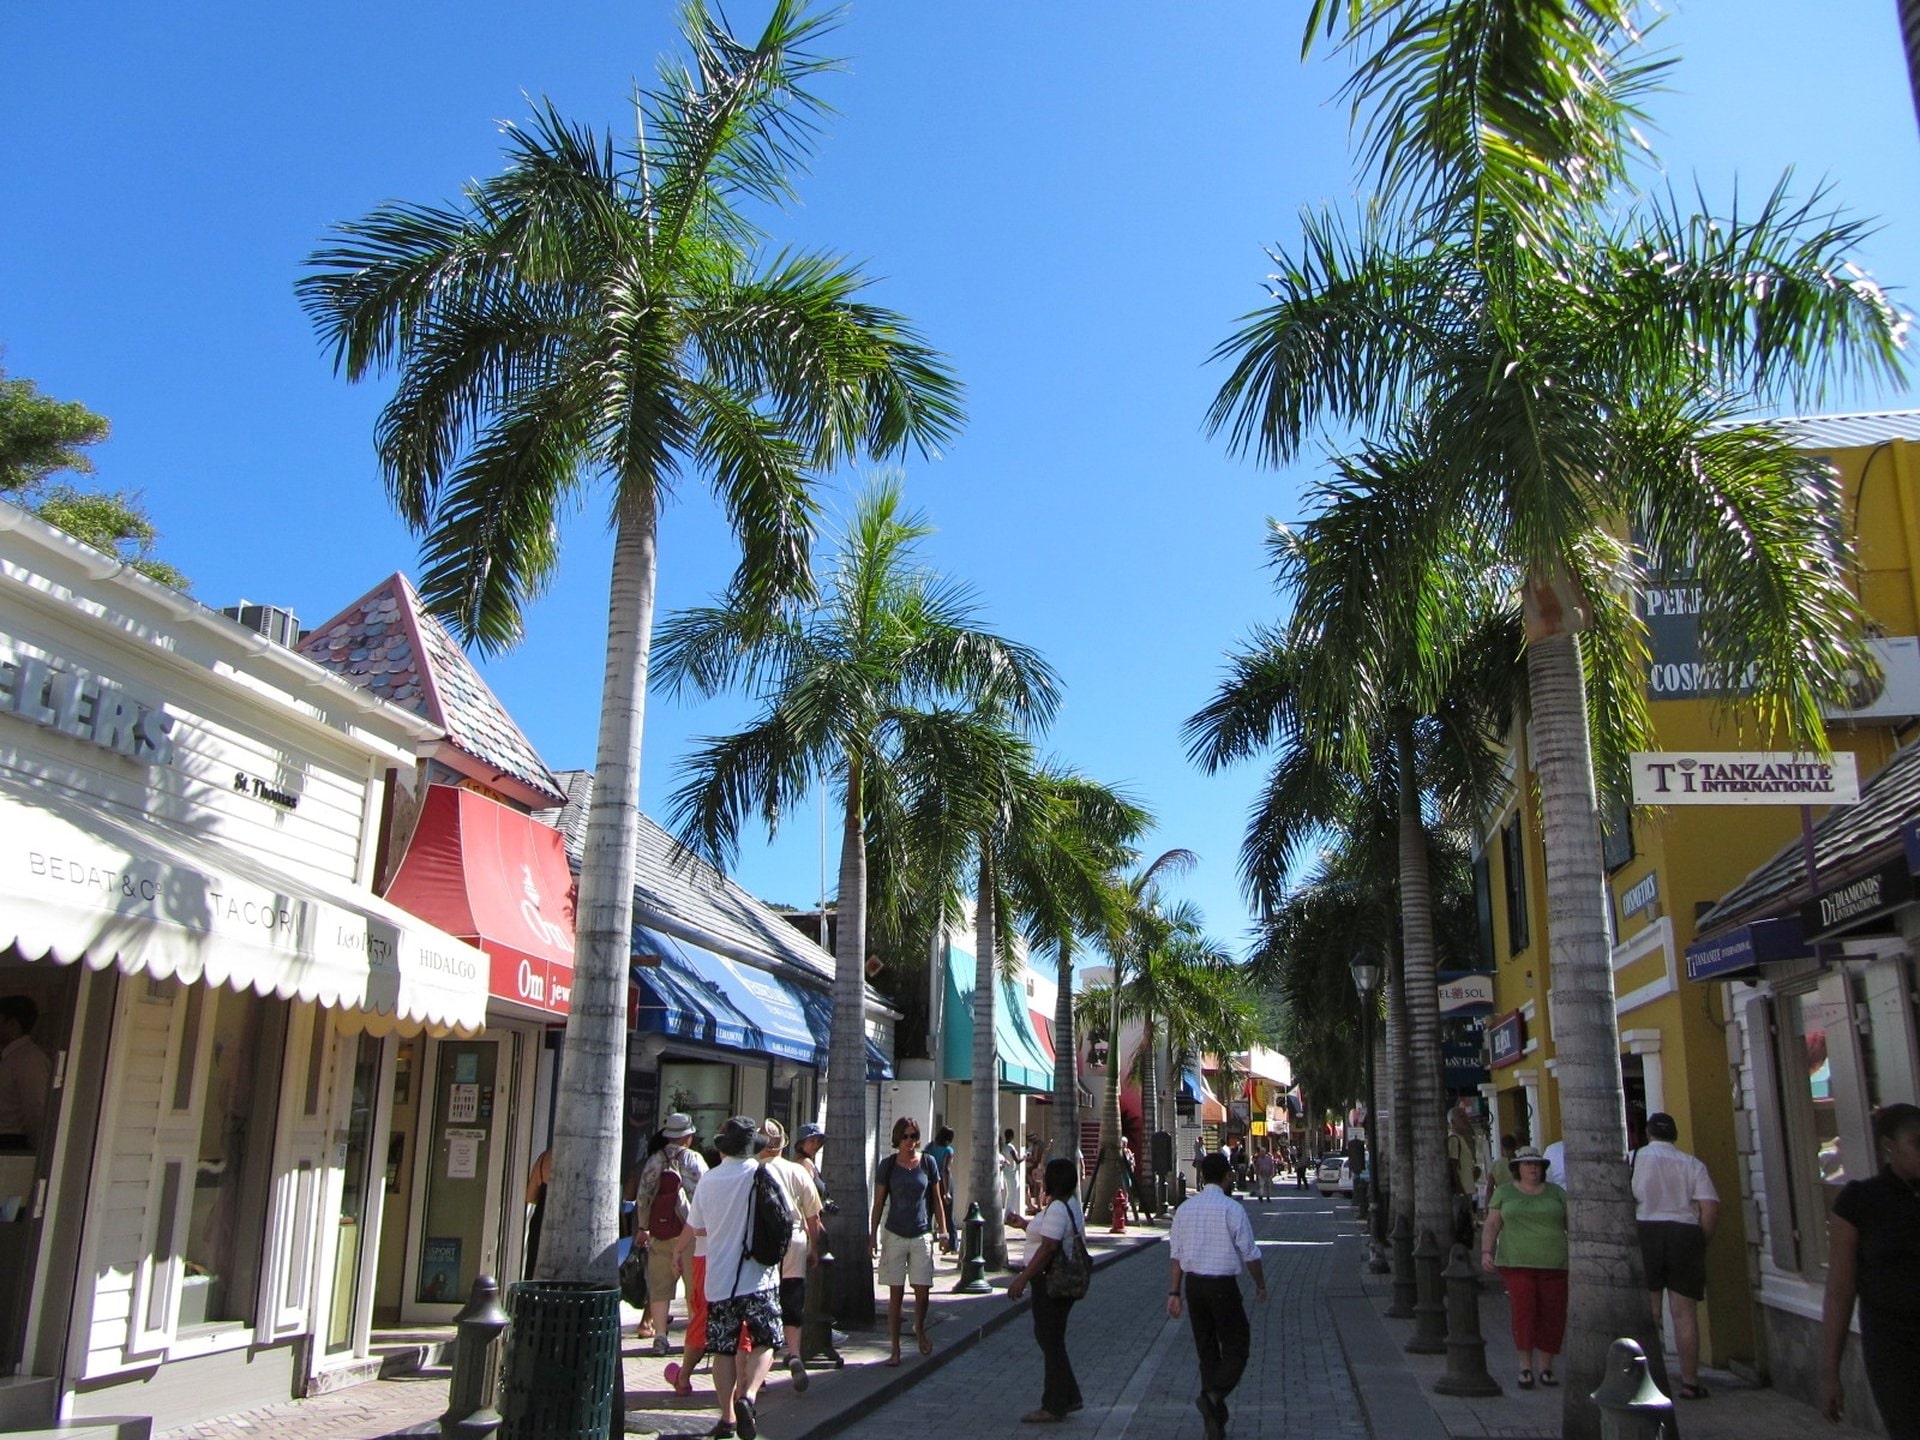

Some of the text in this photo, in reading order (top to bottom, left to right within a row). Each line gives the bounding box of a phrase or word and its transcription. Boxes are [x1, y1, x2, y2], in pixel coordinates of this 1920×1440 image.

[1699, 763, 1833, 781] TANZANITE
[1702, 780, 1834, 793] INTERNATIONAL
[234, 771, 298, 810] St. Thomas
[210, 892, 300, 937] TACORI
[362, 932, 392, 966] Pizzo
[419, 947, 477, 980] HIDALGO
[518, 959, 544, 1001] Om
[1464, 988, 1485, 998] SOL
